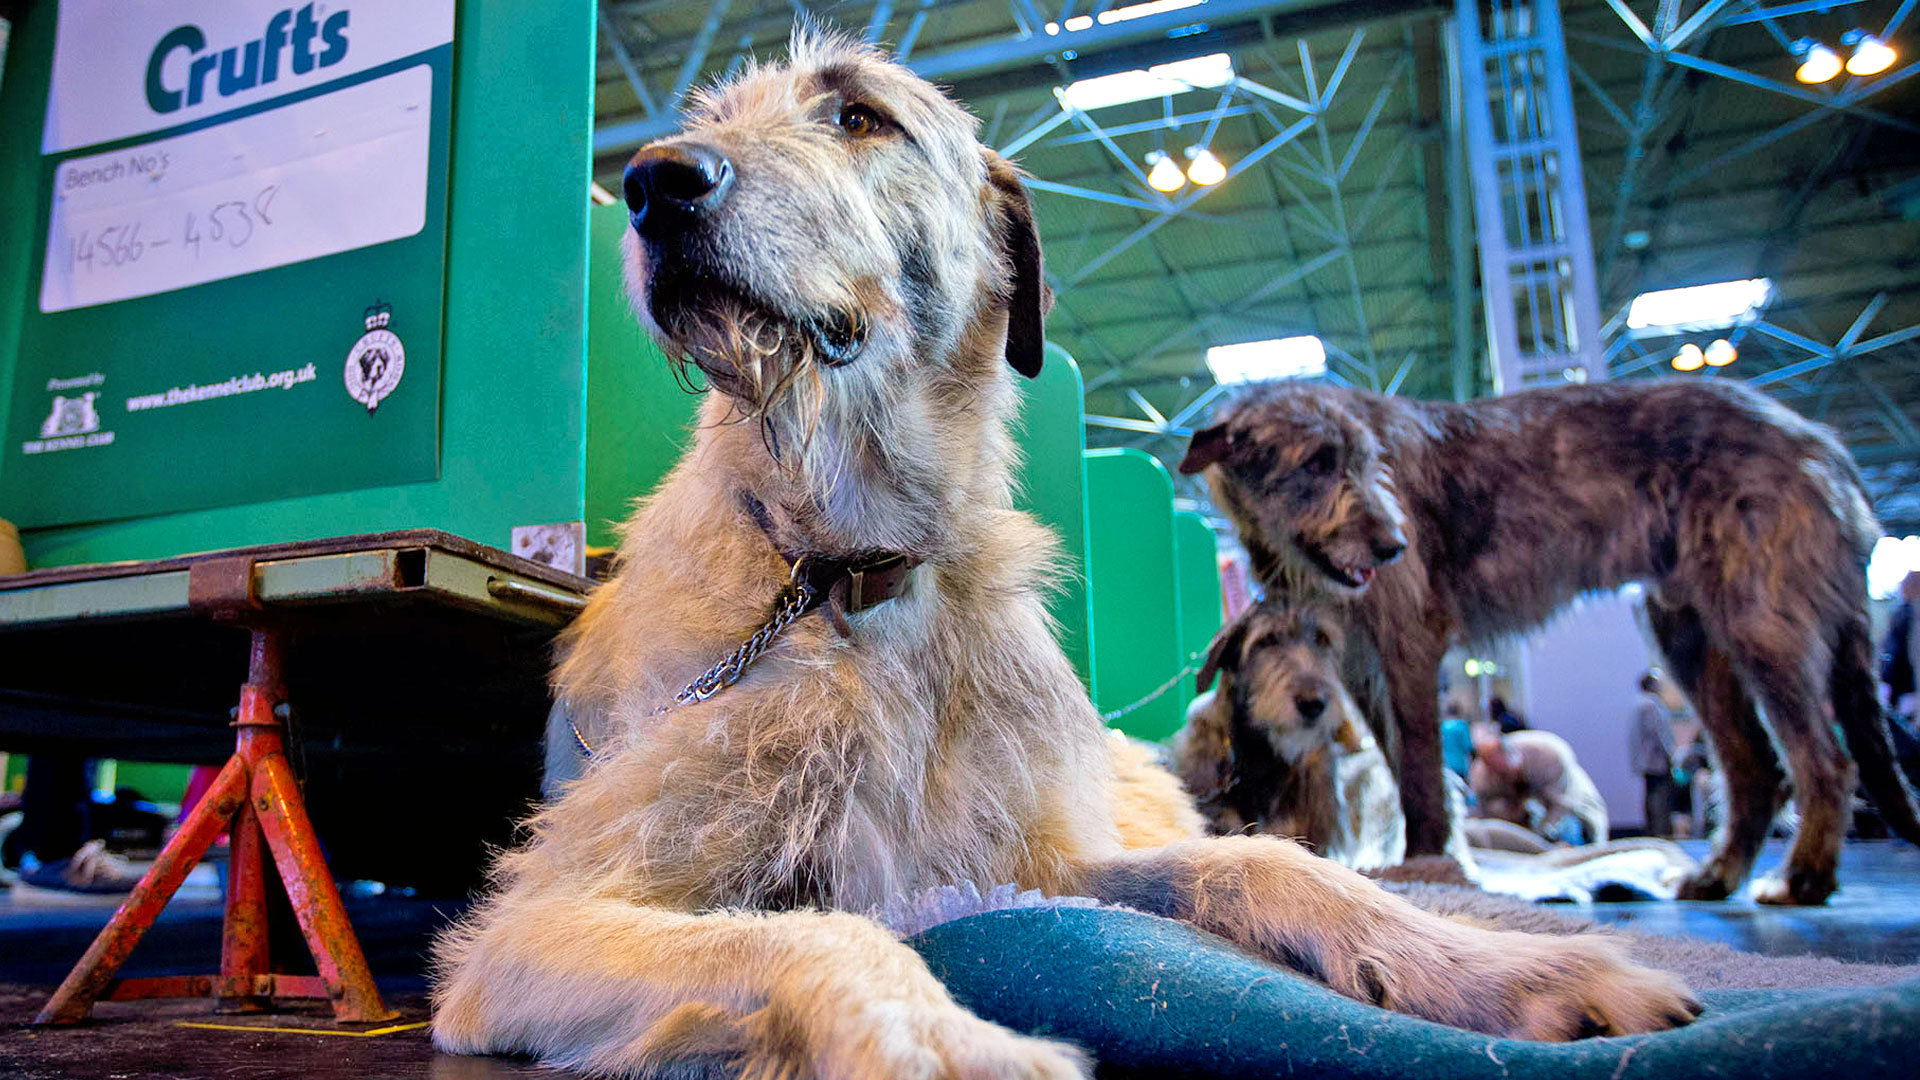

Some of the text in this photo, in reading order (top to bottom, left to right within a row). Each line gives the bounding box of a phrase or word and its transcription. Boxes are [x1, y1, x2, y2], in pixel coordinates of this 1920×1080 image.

[145, 2, 350, 114] Crufts
[64, 161, 125, 190] Bench
[126, 363, 317, 412] www.thekennelclub.org.uk
